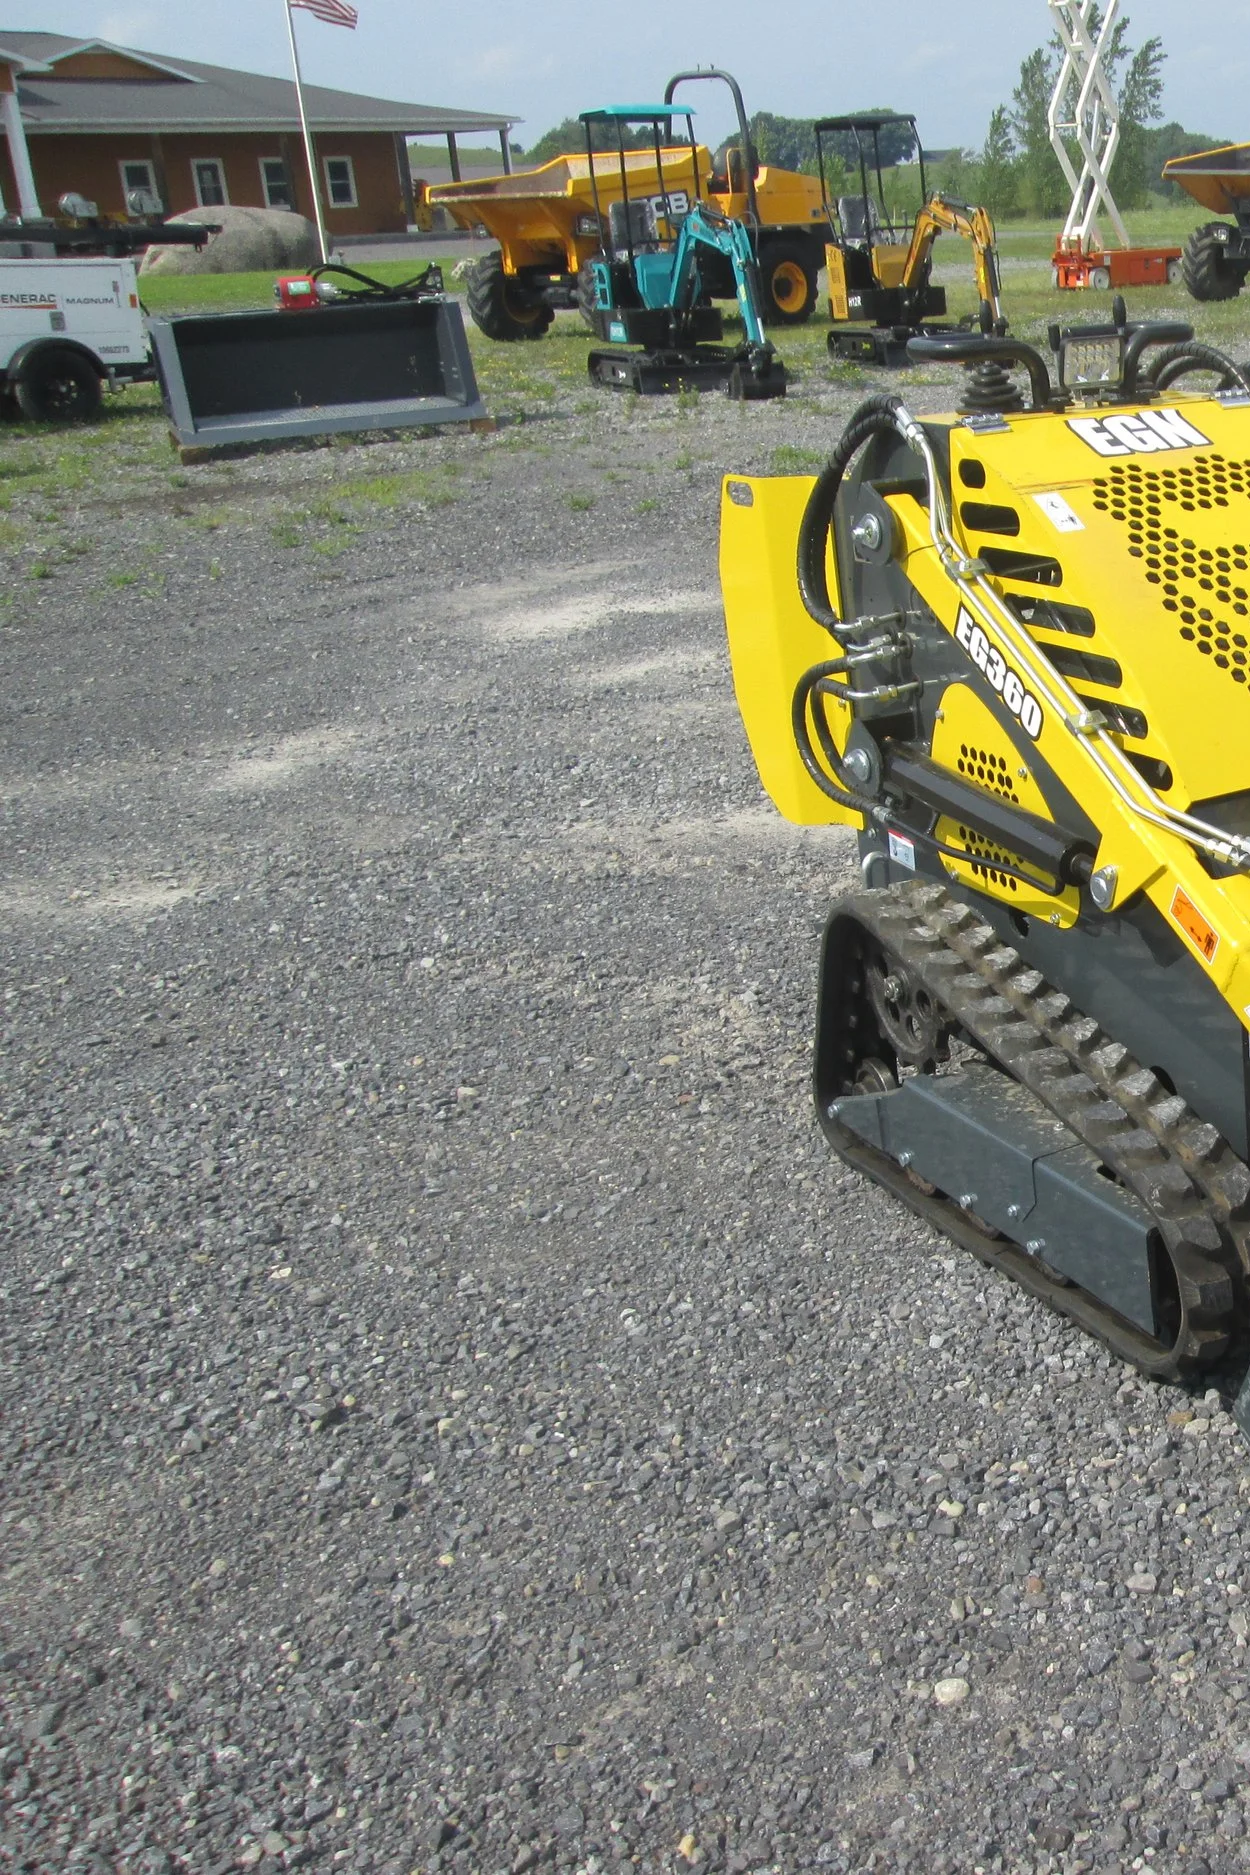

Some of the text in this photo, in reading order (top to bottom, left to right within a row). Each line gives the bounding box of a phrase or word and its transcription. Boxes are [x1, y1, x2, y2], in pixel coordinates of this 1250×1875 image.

[649, 191, 690, 218] CB
[0, 293, 57, 304] ENERAC
[65, 297, 115, 305] MAGNUM
[1065, 408, 1213, 457] EGN
[954, 602, 1043, 740] EG360
